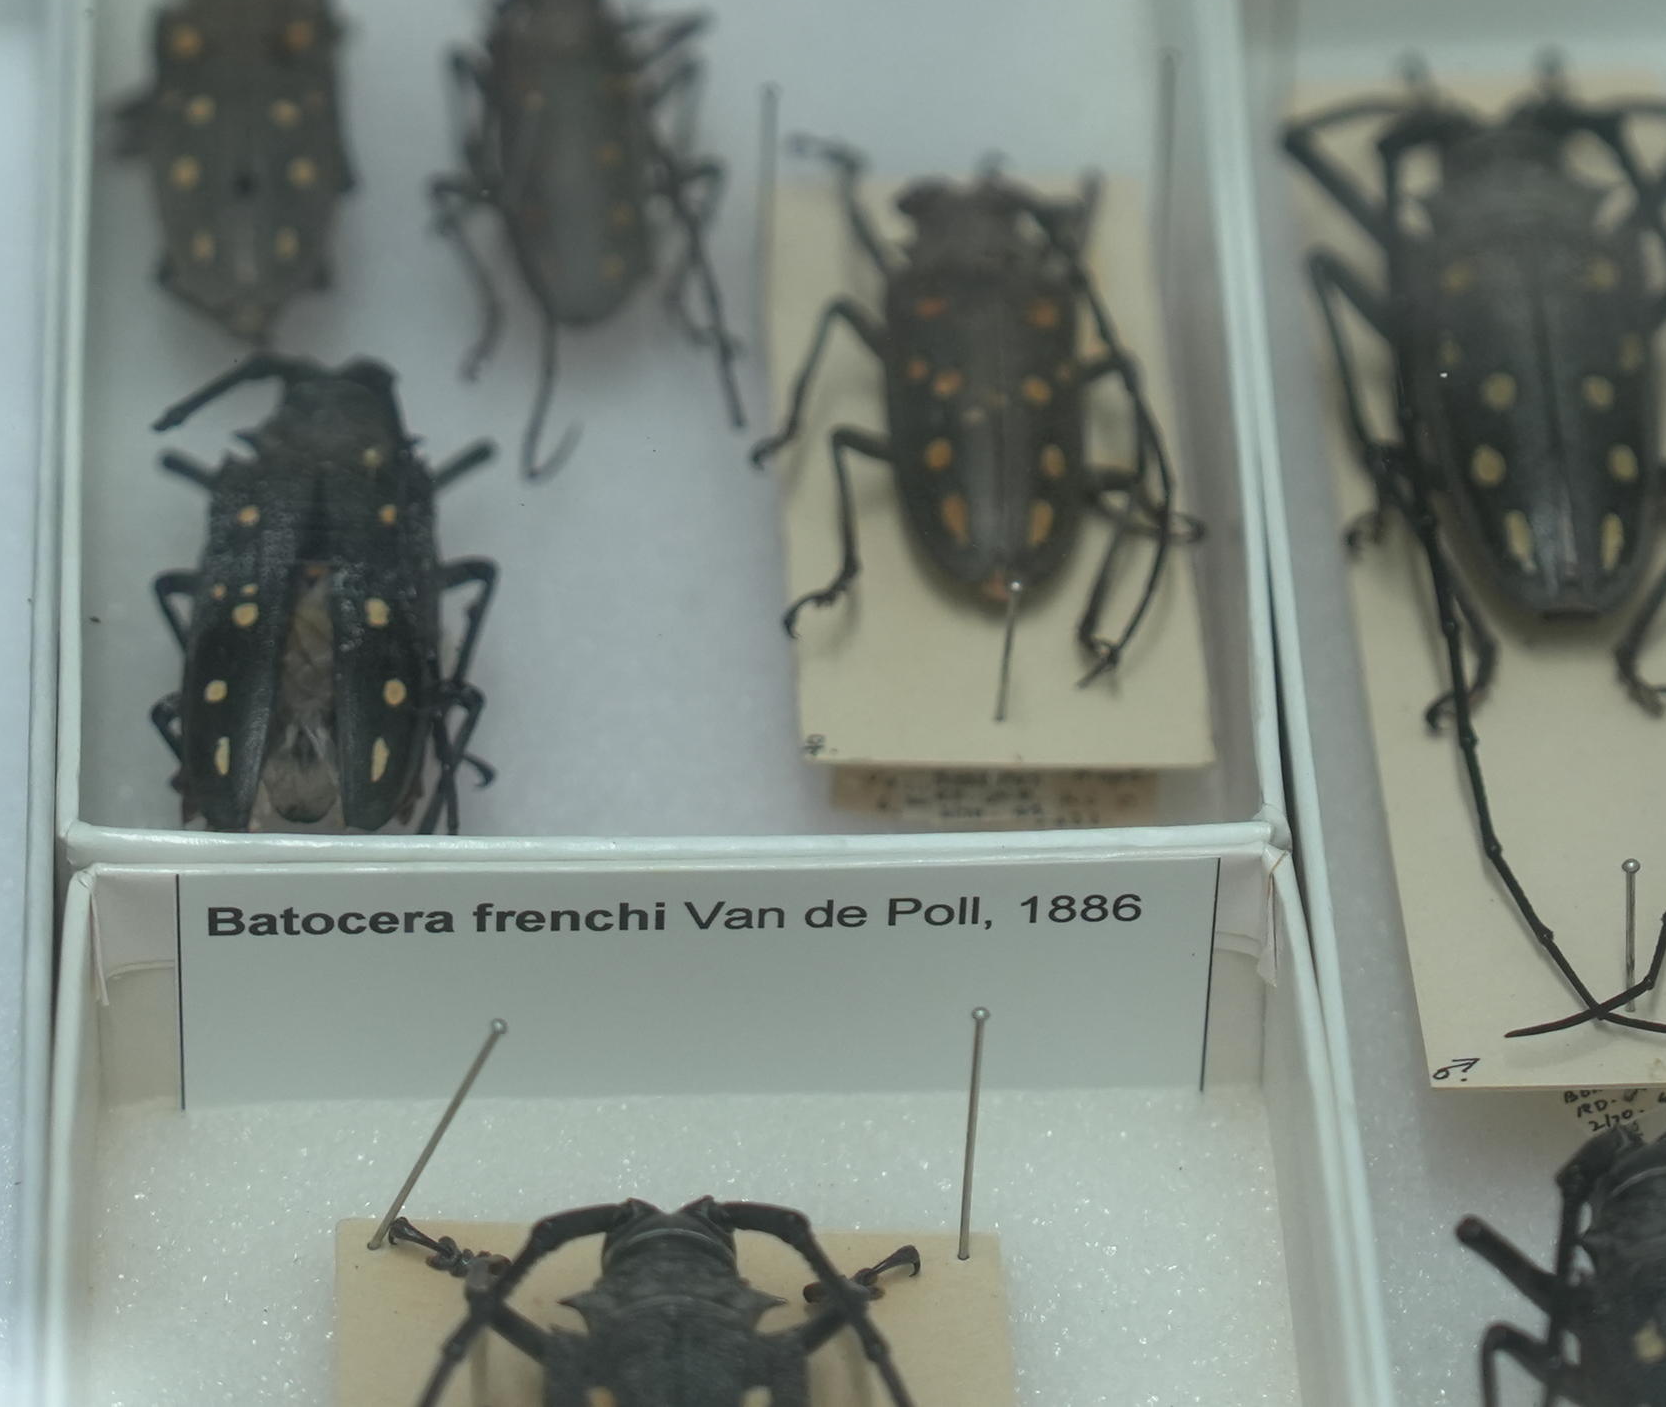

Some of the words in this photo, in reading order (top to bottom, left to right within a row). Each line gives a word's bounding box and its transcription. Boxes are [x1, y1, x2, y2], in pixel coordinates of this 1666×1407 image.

[206, 905, 456, 938] Batocera
[471, 900, 667, 934] frenchi
[682, 899, 786, 932] Van
[803, 898, 869, 930] de
[886, 895, 994, 932] Poll,
[1019, 892, 1143, 925] 1886
